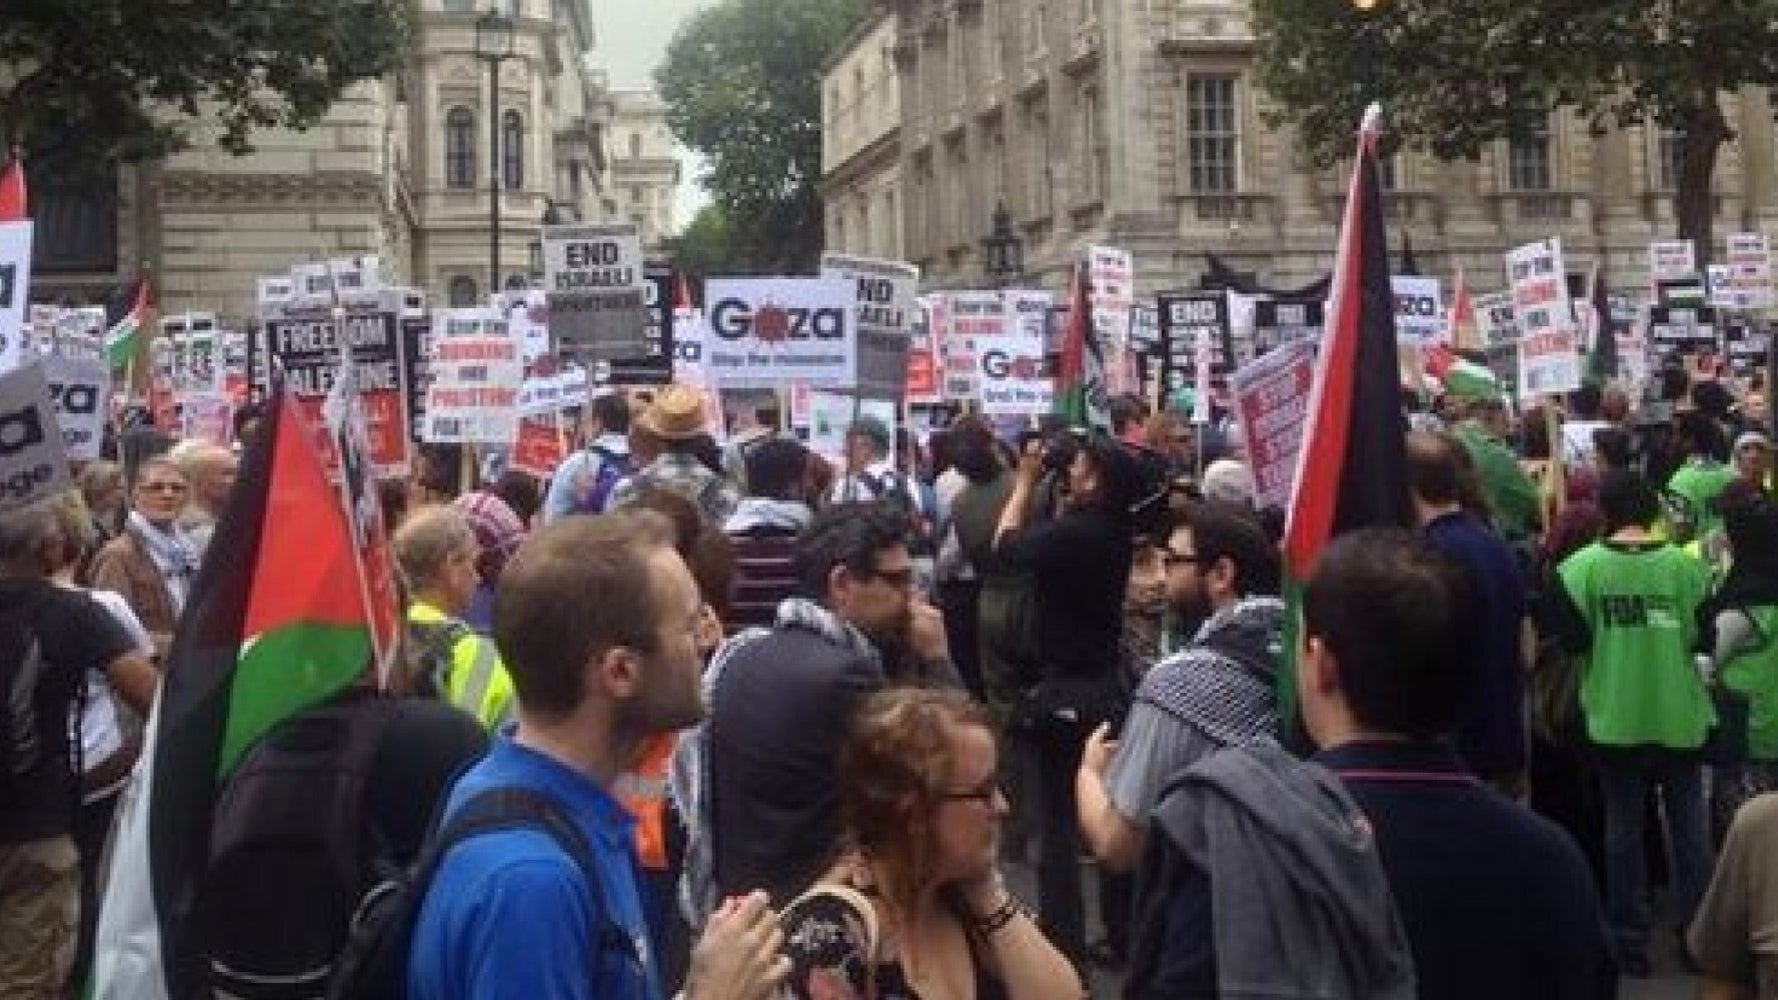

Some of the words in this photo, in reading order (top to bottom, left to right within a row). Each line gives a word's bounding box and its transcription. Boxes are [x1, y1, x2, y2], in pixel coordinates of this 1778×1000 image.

[567, 243, 618, 267] END
[857, 278, 893, 303] ND
[276, 318, 387, 352] FREEOM
